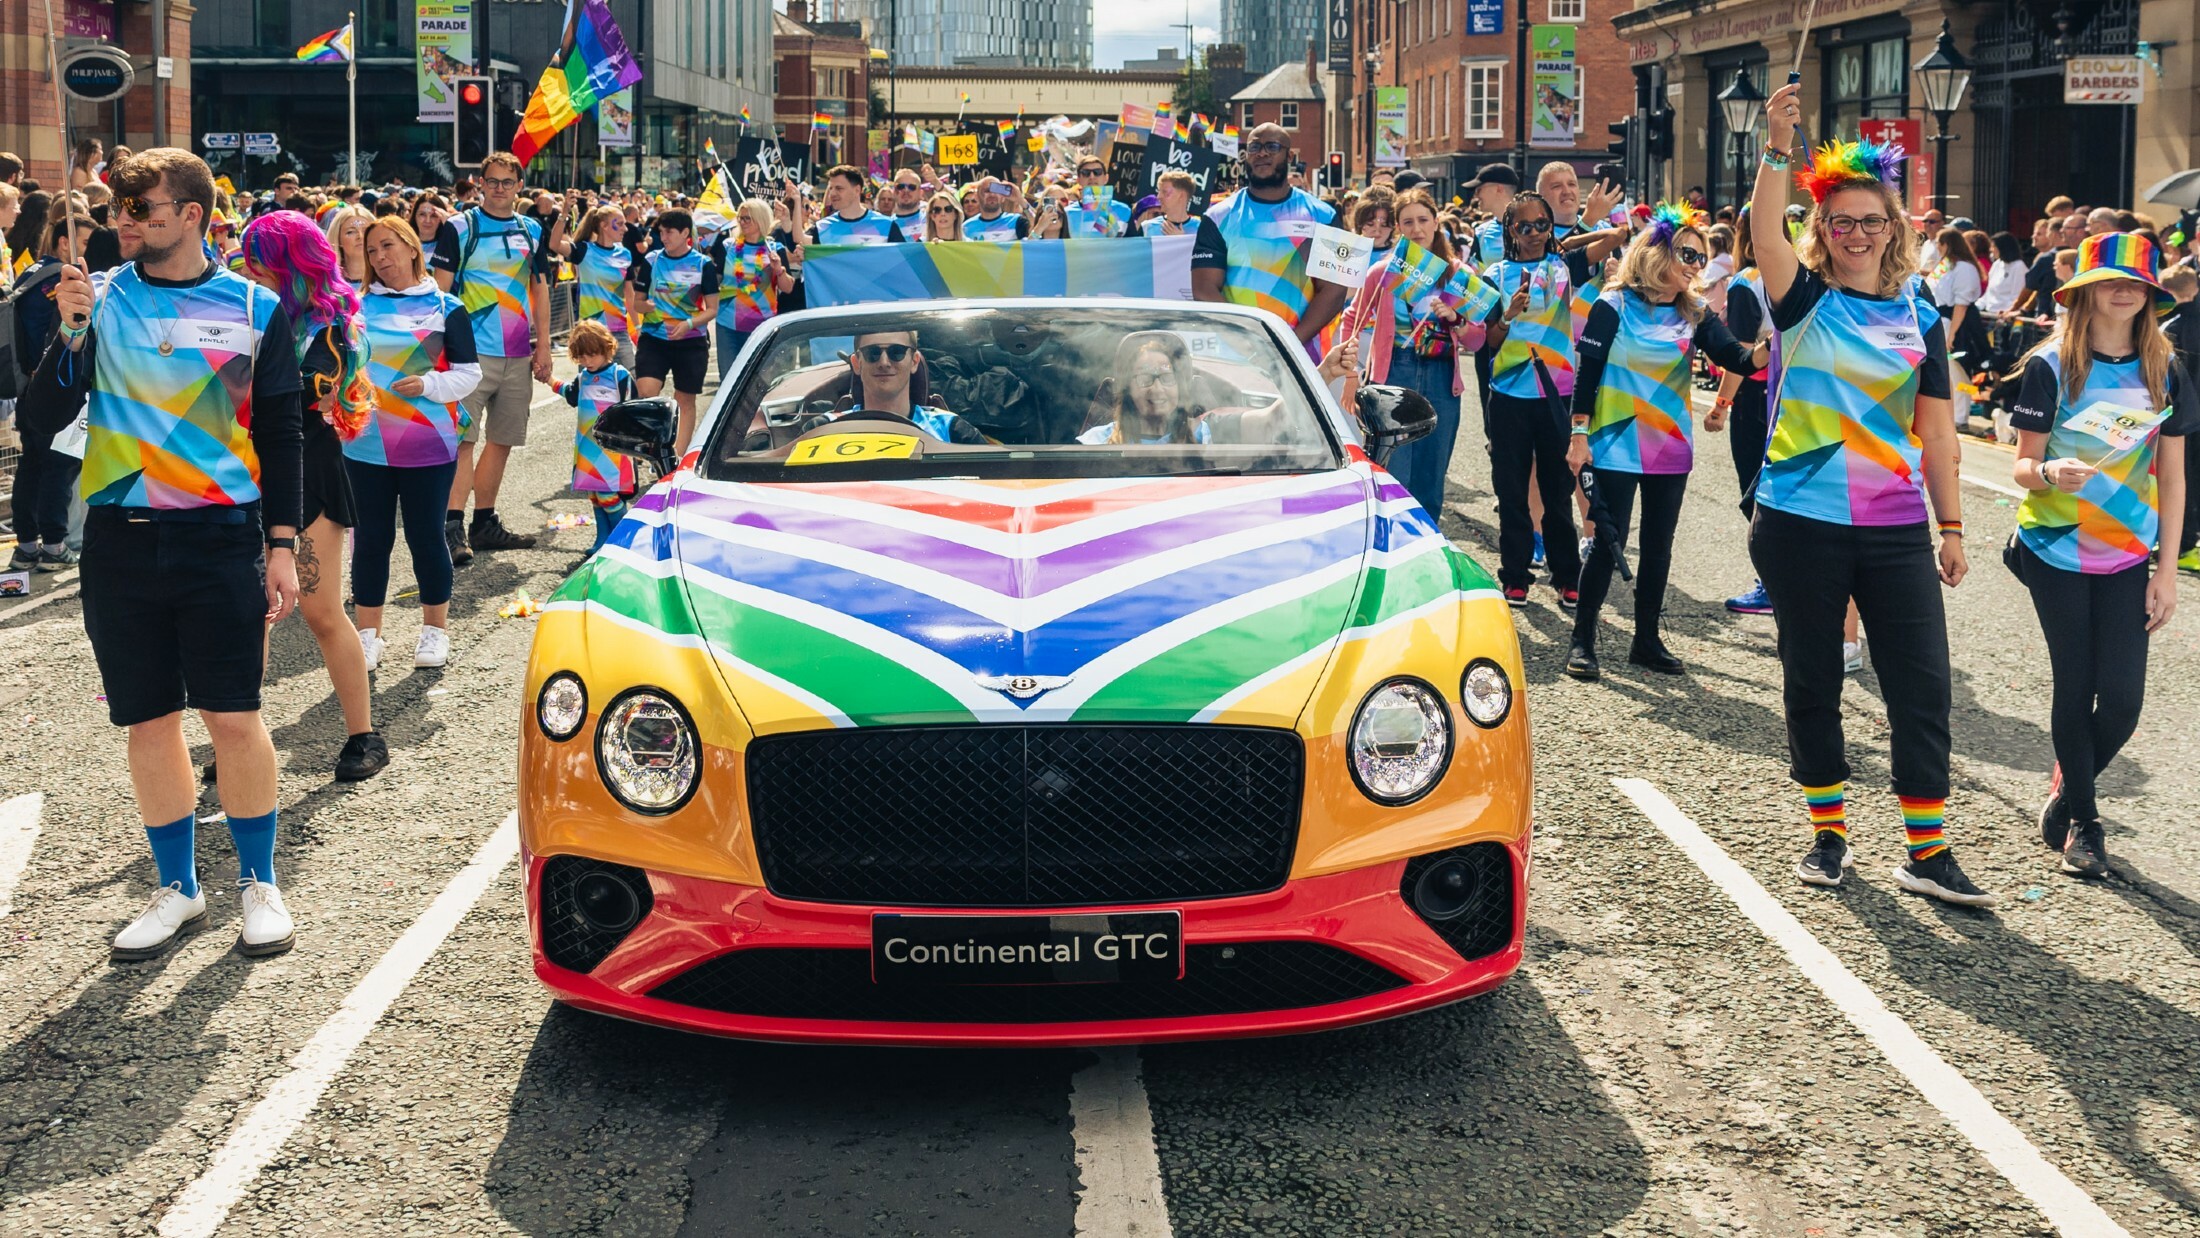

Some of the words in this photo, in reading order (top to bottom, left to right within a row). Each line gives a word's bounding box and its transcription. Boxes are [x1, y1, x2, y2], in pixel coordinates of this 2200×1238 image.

[421, 20, 467, 30] PARADE
[1690, 20, 1725, 49] Spanish
[1726, 15, 1773, 40] Language
[1537, 63, 1572, 71] PARADE
[2070, 77, 2139, 89] BARBERS
[944, 143, 975, 159] 168
[1168, 141, 1193, 168] be
[1318, 259, 1360, 277] BENTLEY
[199, 337, 229, 345] BENTLEY
[1579, 334, 1602, 348] clusive
[2013, 404, 2045, 418] clusive
[807, 440, 907, 459] 167
[884, 936, 1080, 965] Continental
[1093, 933, 1169, 961] GTC
